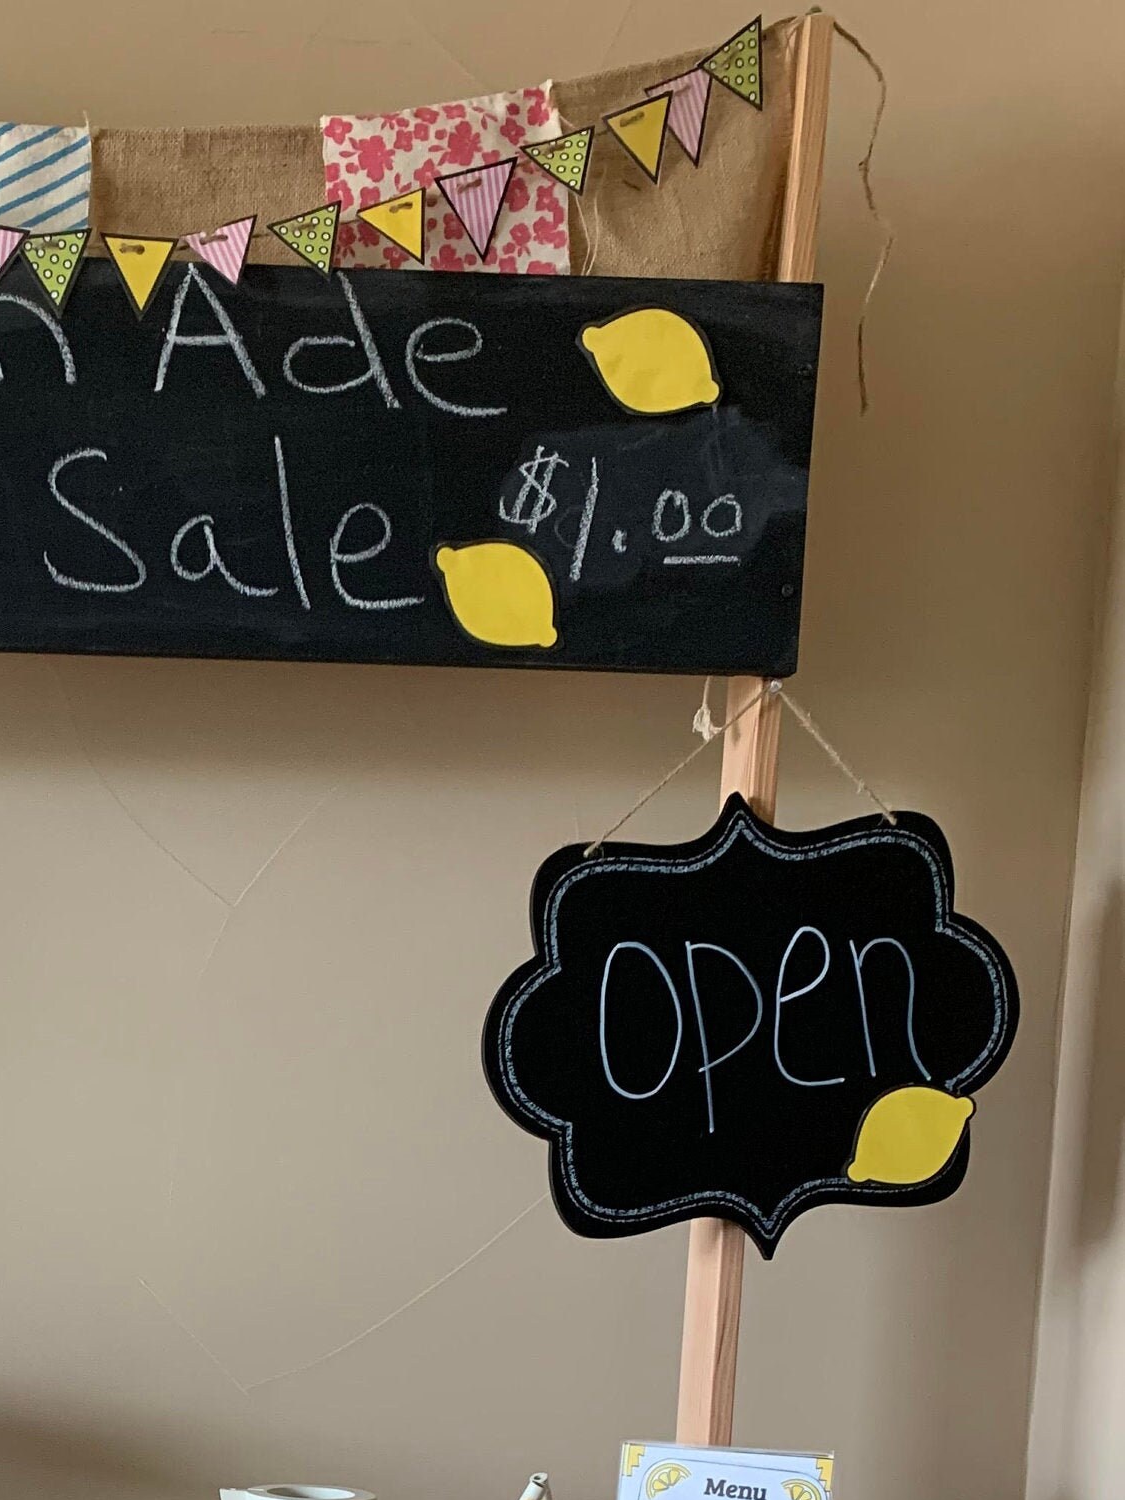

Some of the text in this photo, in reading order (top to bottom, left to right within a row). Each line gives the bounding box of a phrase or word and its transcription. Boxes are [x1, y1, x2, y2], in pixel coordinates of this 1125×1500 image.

[154, 262, 507, 417] Ade
[43, 436, 425, 610] Sale
[499, 446, 744, 580] $1.00
